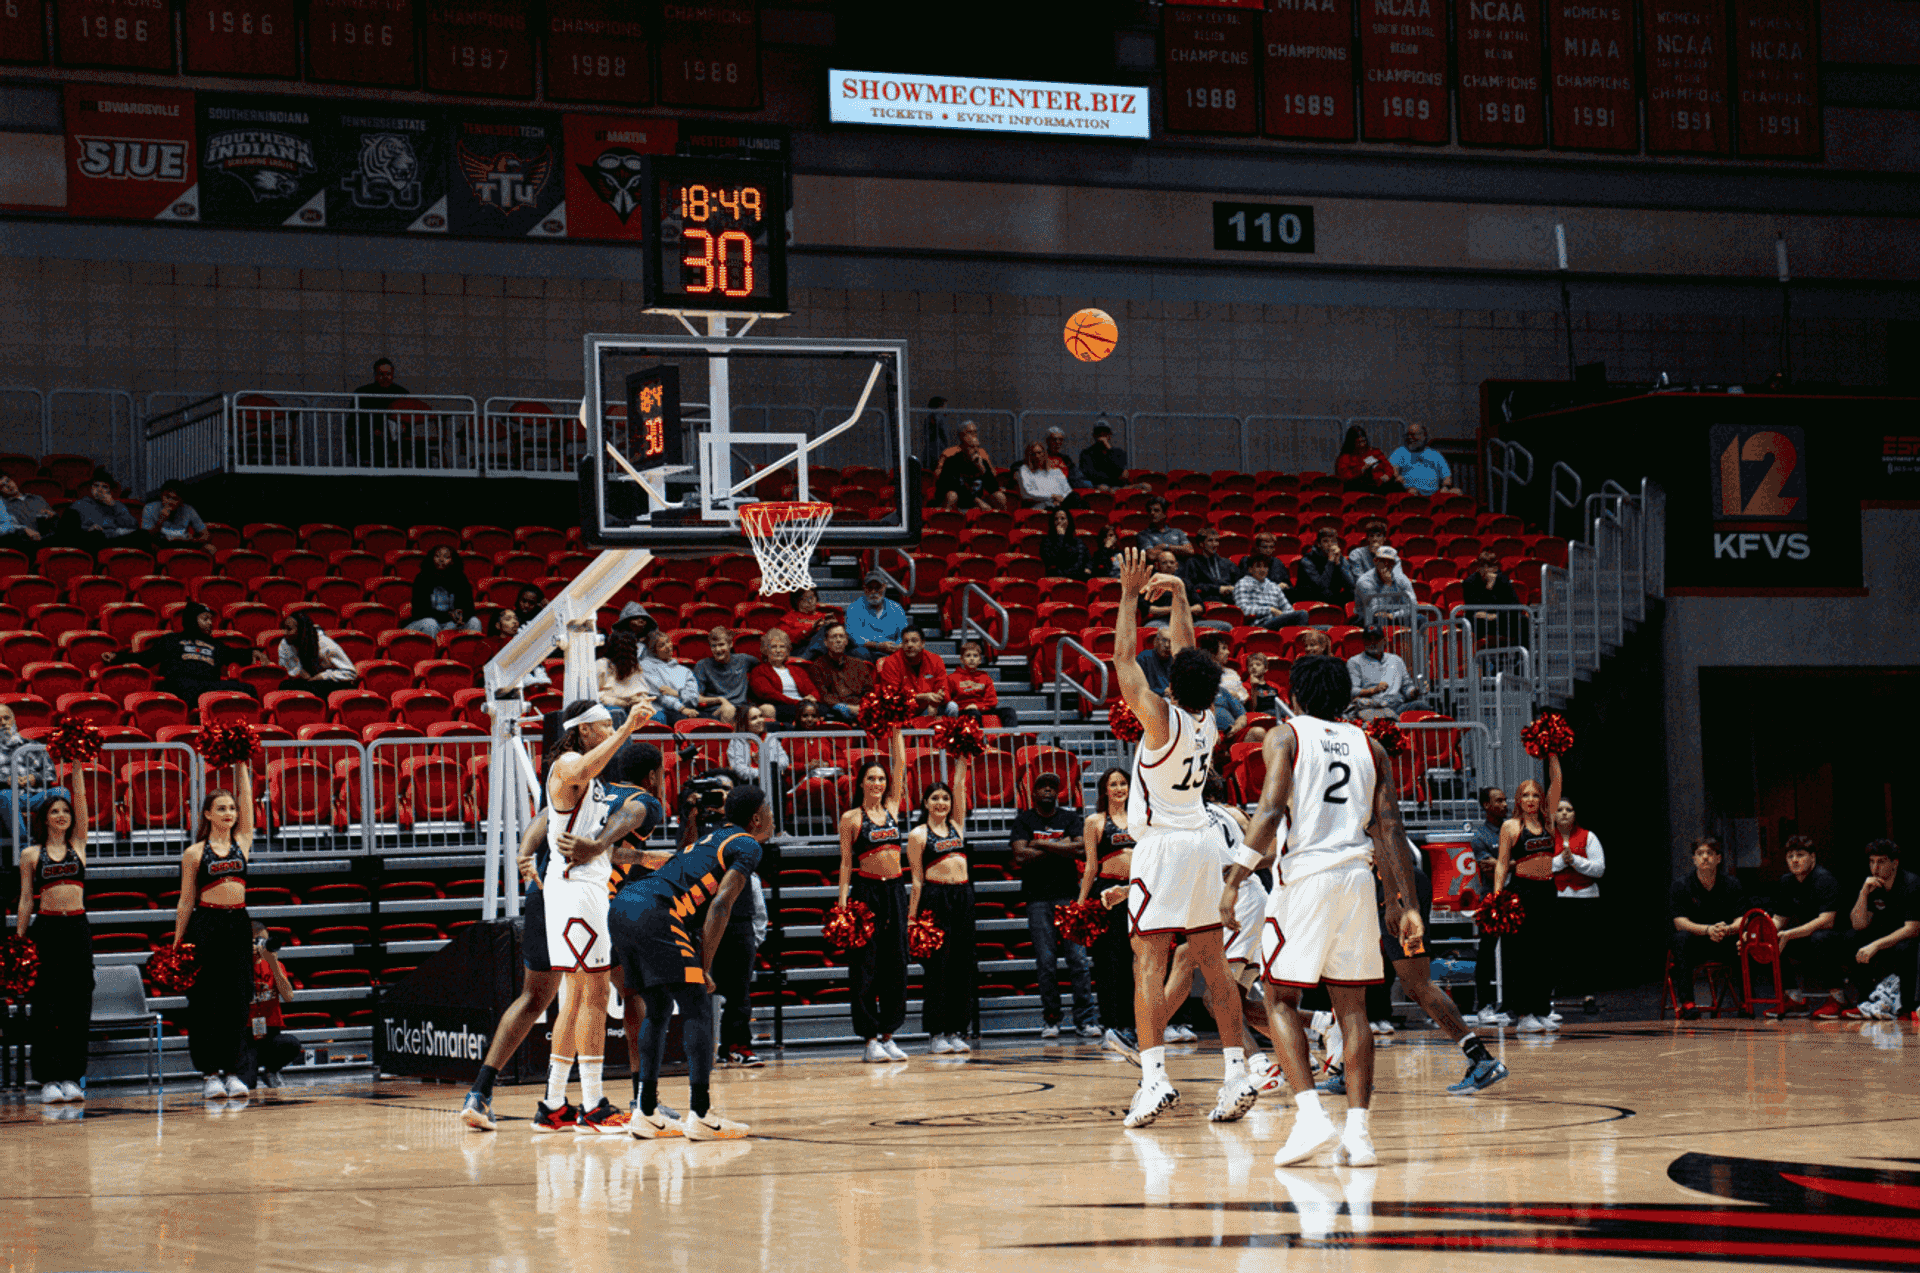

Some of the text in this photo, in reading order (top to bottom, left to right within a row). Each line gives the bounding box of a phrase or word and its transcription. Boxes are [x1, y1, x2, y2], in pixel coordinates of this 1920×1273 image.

[1374, 0, 1431, 18] NCAA
[1470, 2, 1526, 22] NCAA
[81, 15, 149, 41] 1986
[208, 10, 273, 35] 1986
[1267, 43, 1347, 61] CHAMPIONS
[1564, 36, 1621, 59] MIAA
[1657, 34, 1714, 55] NCAA
[451, 45, 509, 70] 1987
[572, 53, 627, 77] 1988
[683, 59, 738, 84] 1988
[1367, 68, 1443, 86] CHAMPIONS
[1463, 74, 1538, 91] CHAMPIONS
[1556, 73, 1631, 91] CHAMPIONS
[842, 78, 1137, 115] SHOWMECENTER.BIZ
[1186, 87, 1237, 111] 1988
[1283, 93, 1335, 117] 1989
[1383, 95, 1430, 121] 1989
[870, 106, 1111, 130] TICKETS EVENT INFORMATION
[1478, 101, 1526, 124] 1990
[1573, 106, 1615, 128] 1991
[1670, 110, 1711, 131] 1991
[1758, 115, 1800, 136] 1991
[209, 131, 309, 156] SOUTHERN
[82, 140, 184, 178] SIUE
[207, 143, 314, 169] INDIANA
[681, 184, 761, 222] 18:49
[1228, 210, 1302, 245] 110
[683, 229, 753, 297] 30
[1720, 430, 1800, 516] 12
[1713, 533, 1811, 560] KFVS
[1320, 739, 1349, 756] WARD
[1323, 761, 1351, 804] 2
[1456, 851, 1477, 876] G
[384, 1018, 486, 1061] TicketSmarter
